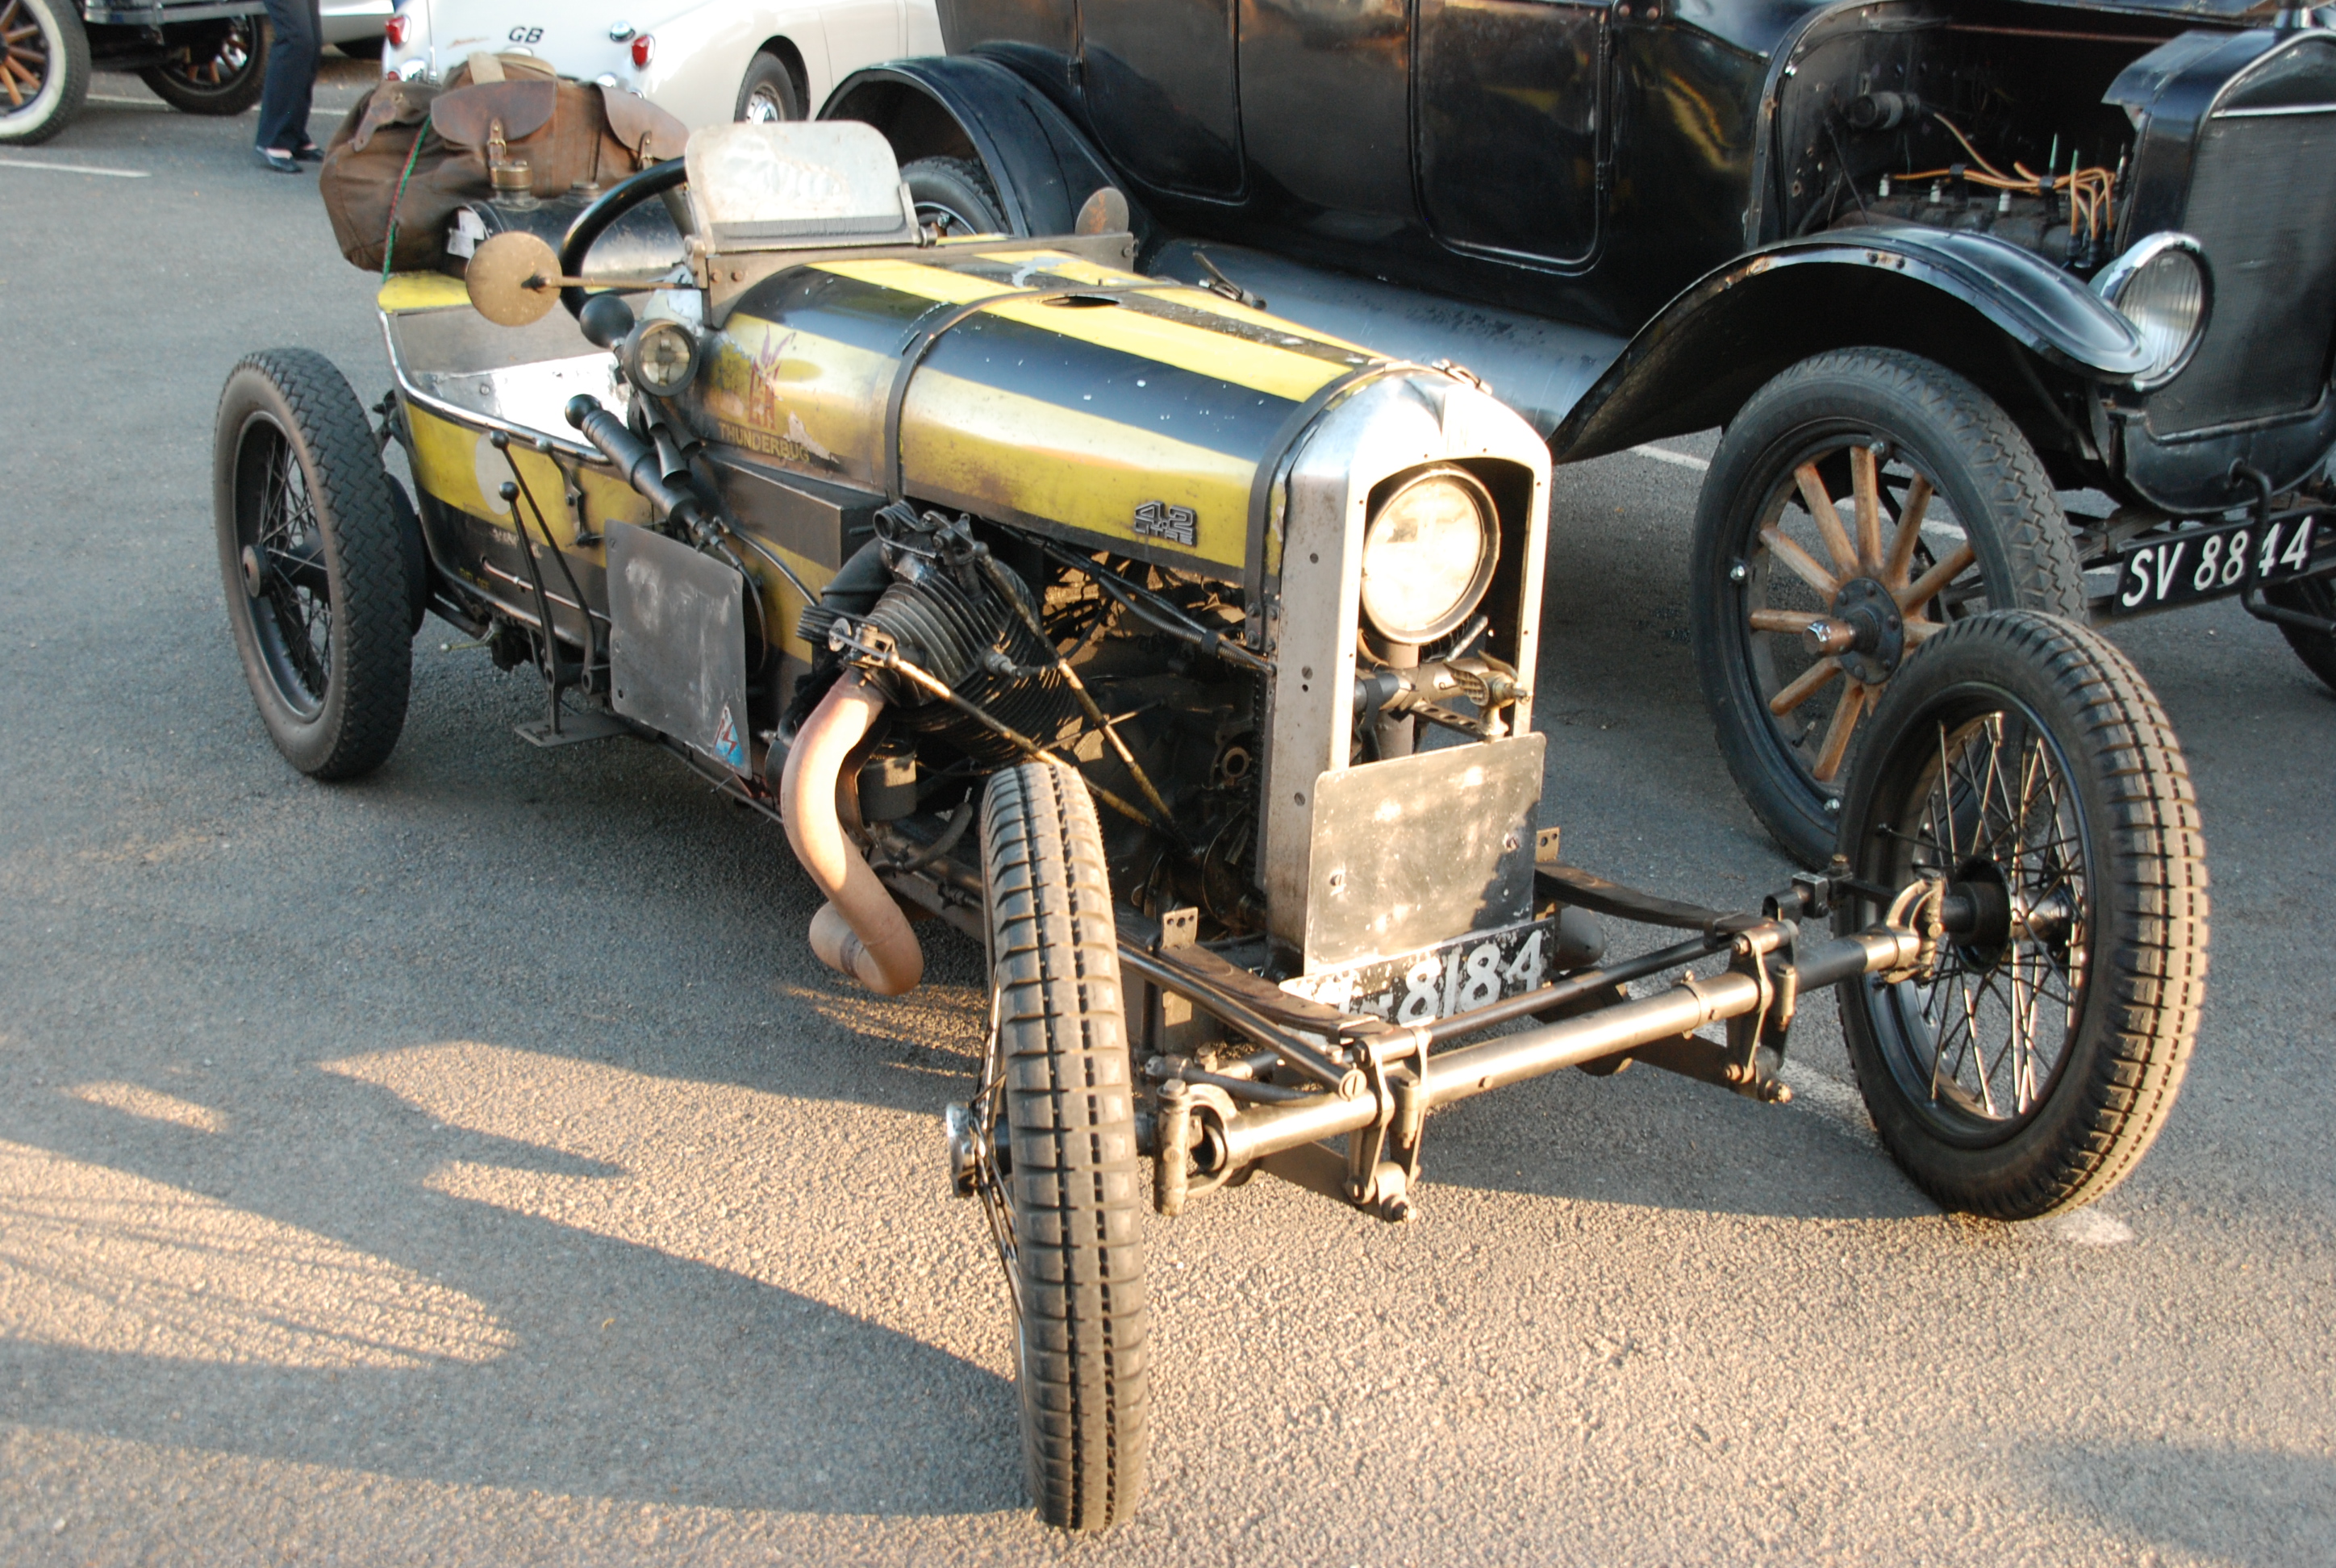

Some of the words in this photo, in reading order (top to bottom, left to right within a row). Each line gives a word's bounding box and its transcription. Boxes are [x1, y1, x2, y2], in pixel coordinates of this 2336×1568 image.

[508, 27, 545, 44] GB
[718, 422, 811, 463] THUNDERBUG
[1134, 501, 1195, 536] 4.2
[1134, 519, 1195, 546] LITRE
[2121, 541, 2185, 607] SV
[2193, 515, 2313, 591] 8844
